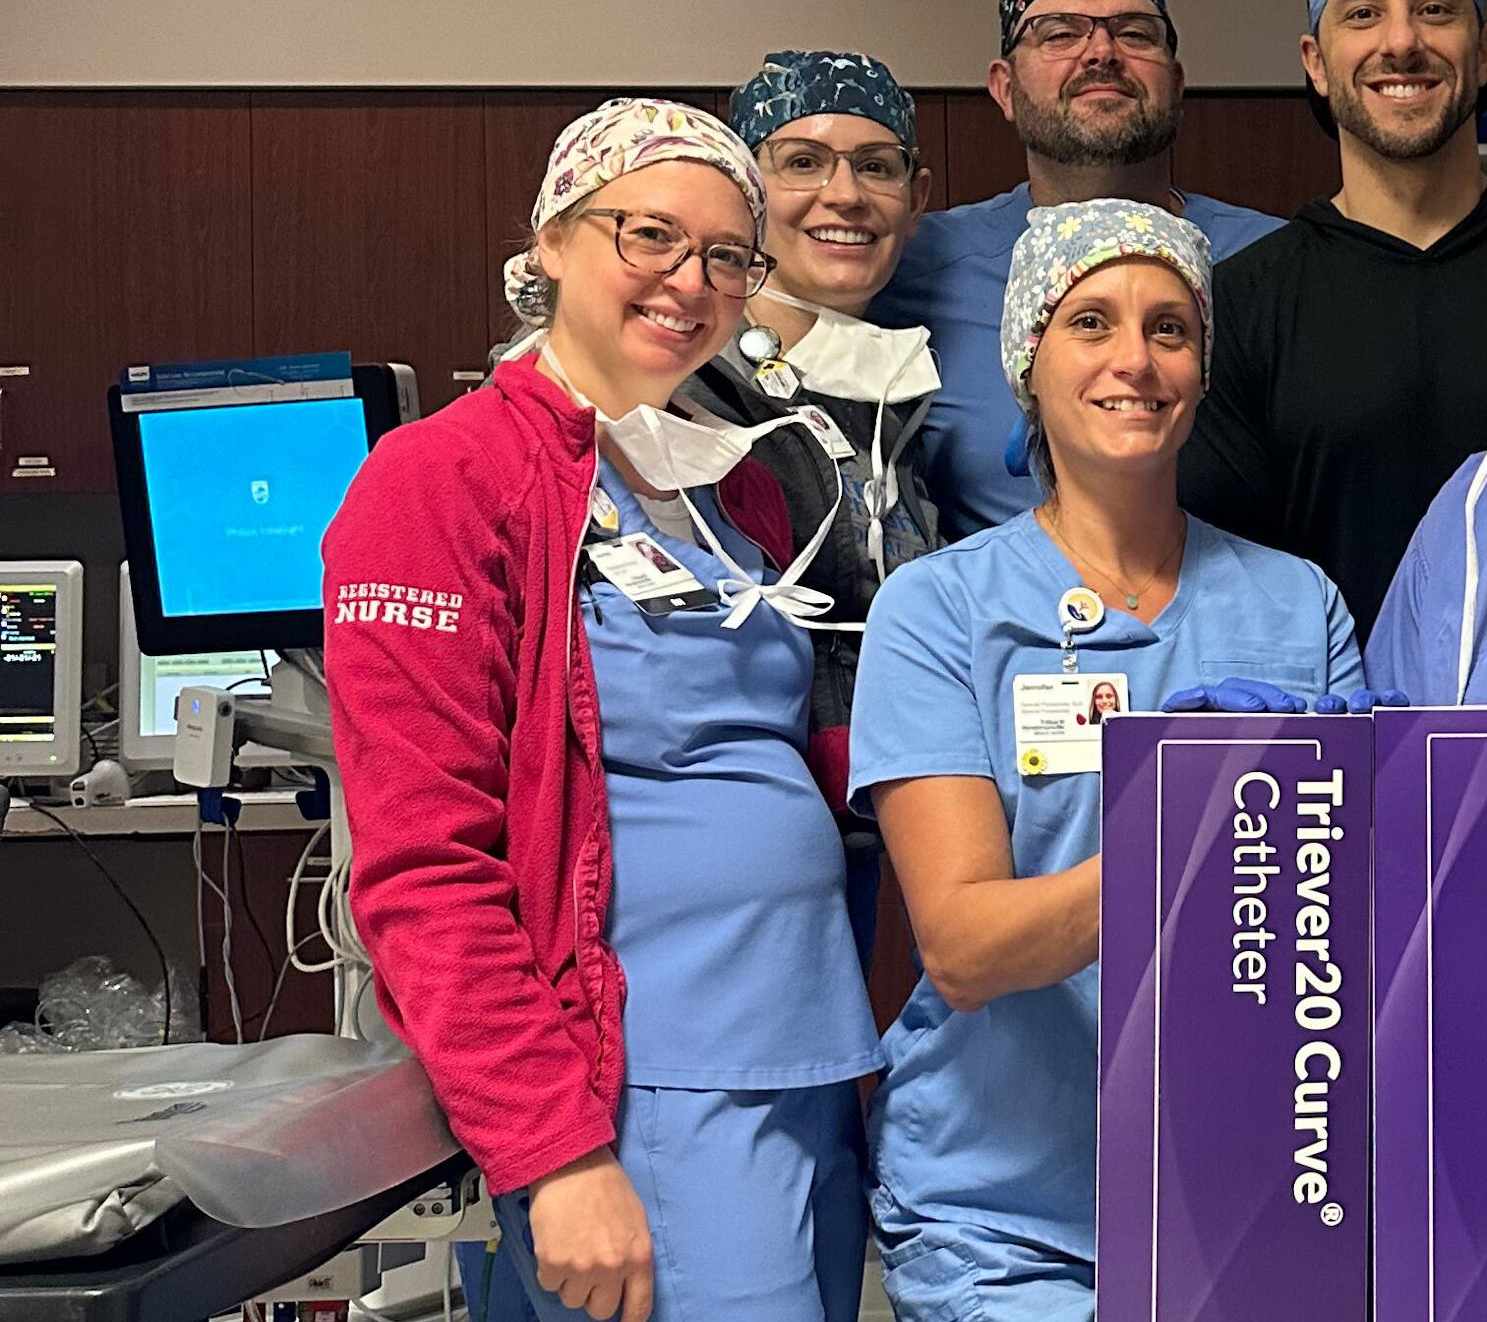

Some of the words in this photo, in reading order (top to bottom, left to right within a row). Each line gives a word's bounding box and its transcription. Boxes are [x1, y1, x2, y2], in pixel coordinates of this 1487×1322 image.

[334, 600, 460, 633] NURSE
[337, 582, 463, 609] REGISTERED
[1232, 771, 1281, 1005] Catheter
[1294, 769, 1344, 1031] Triever20
